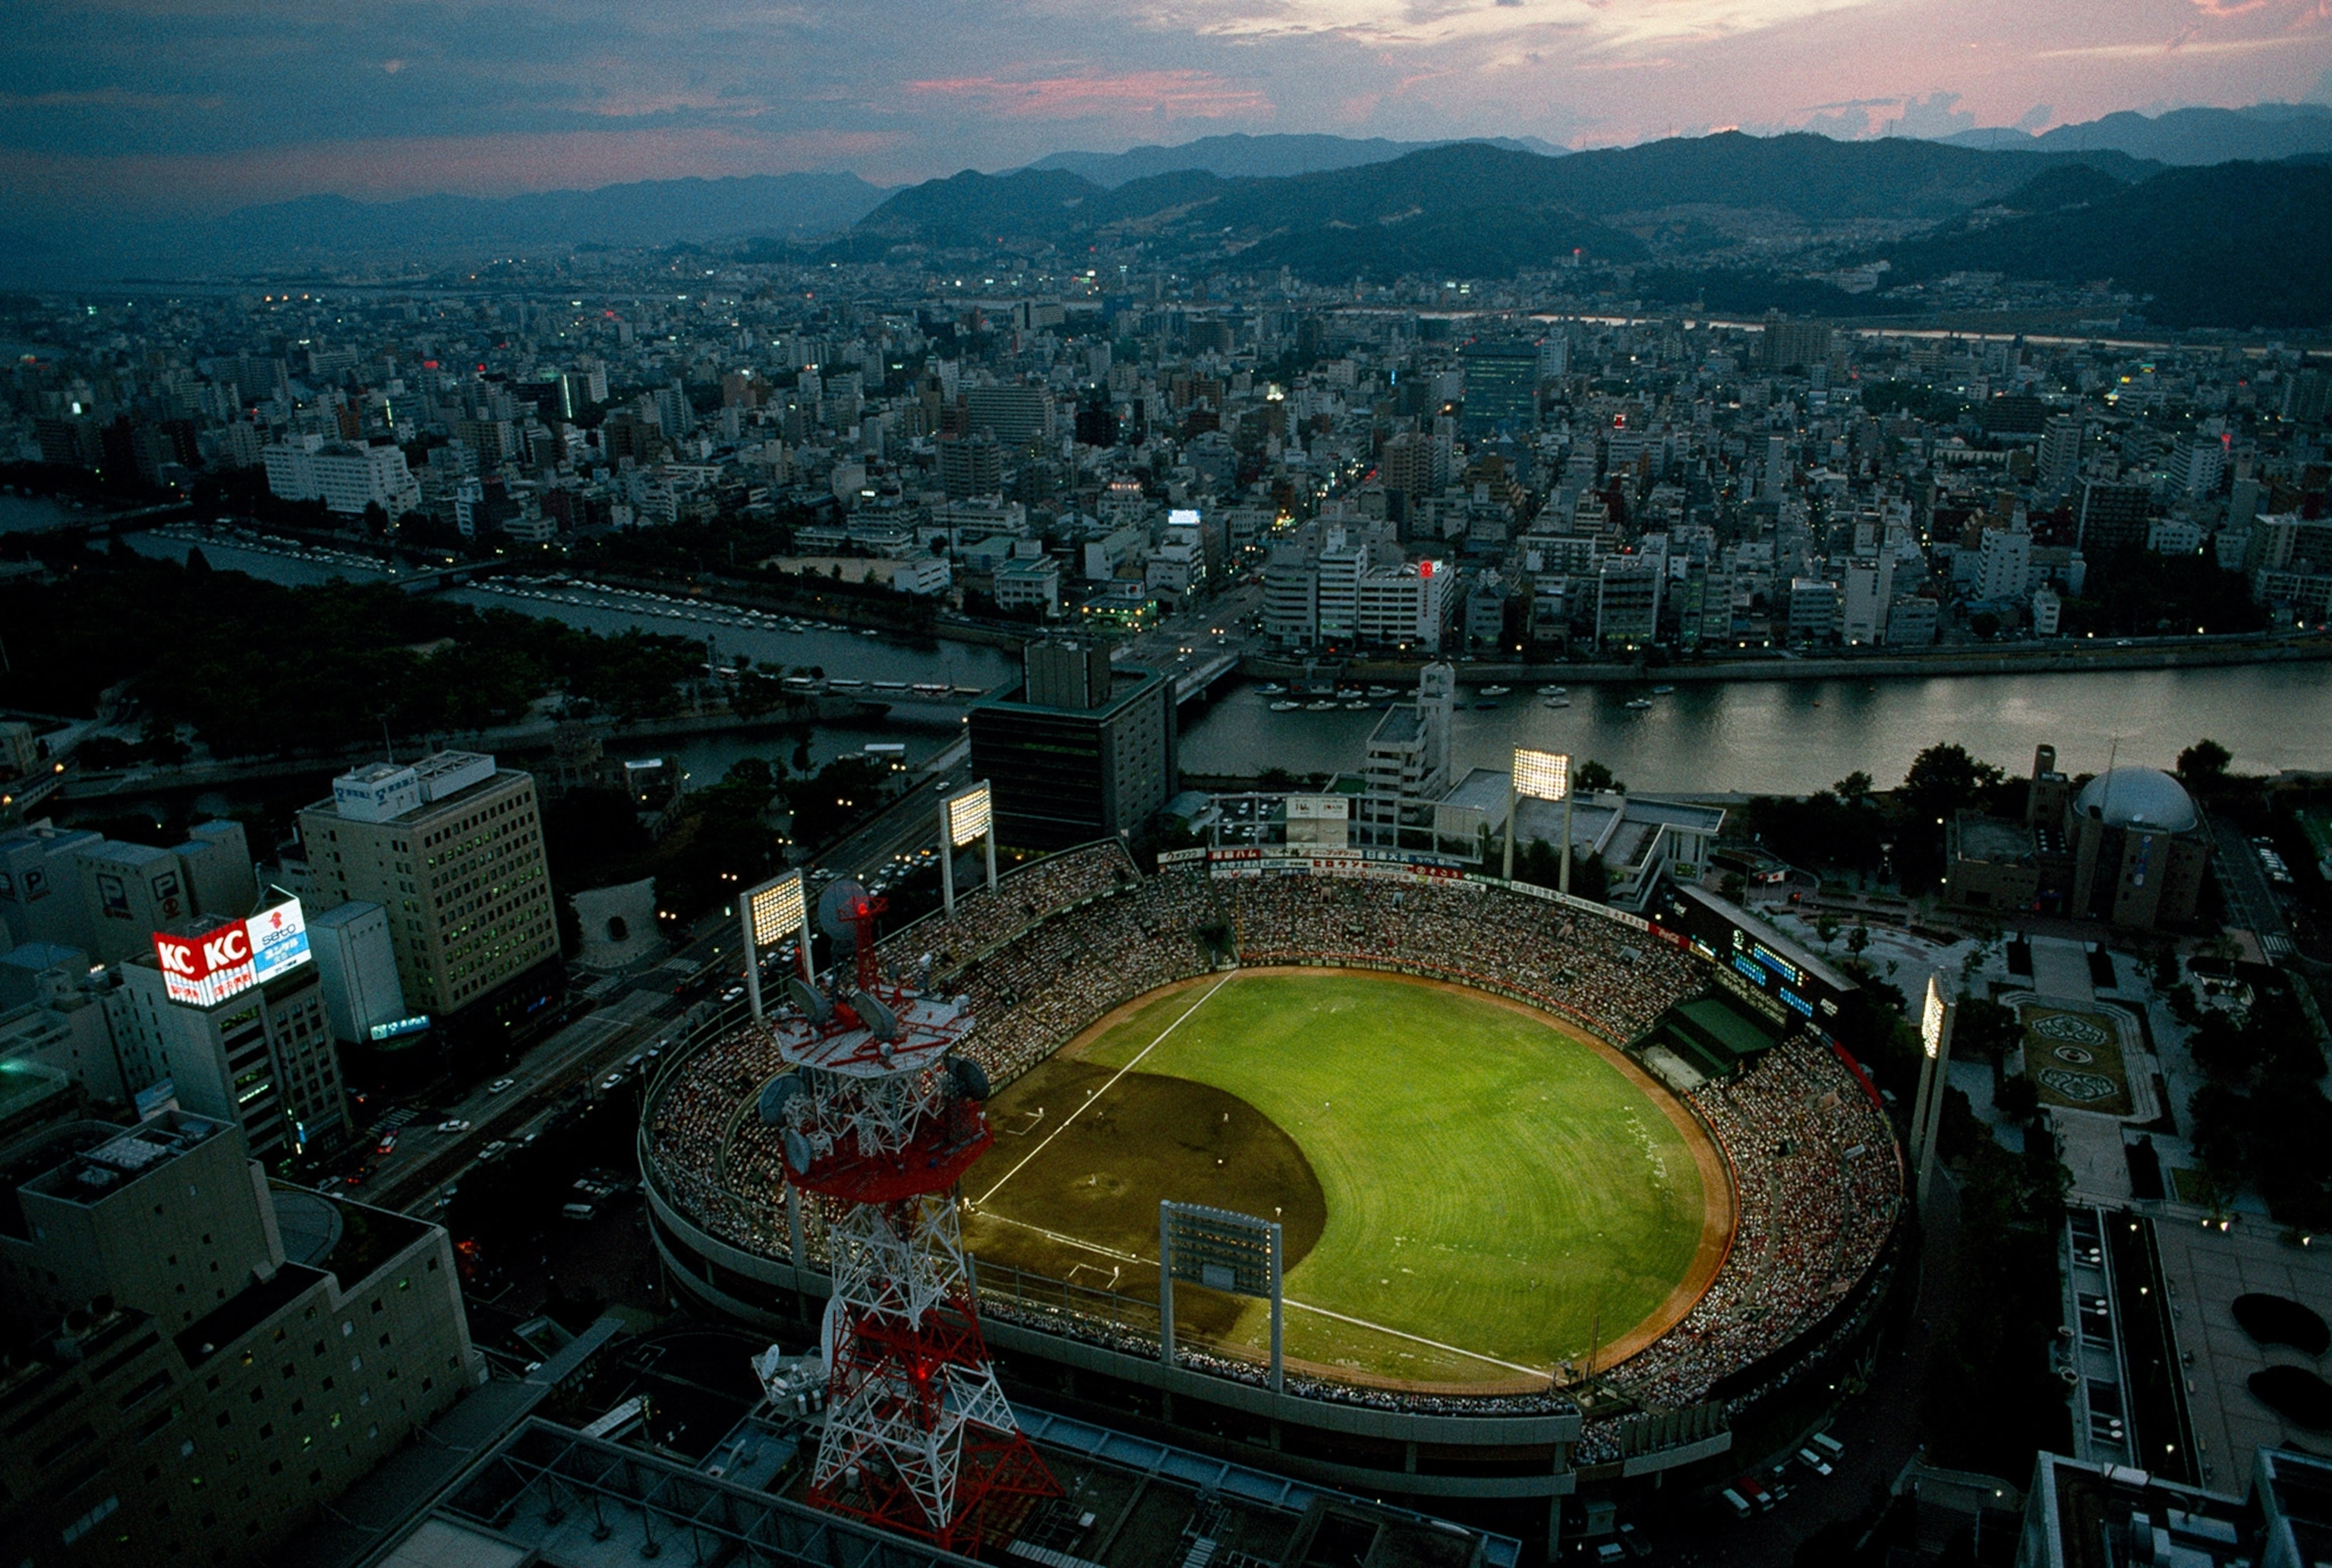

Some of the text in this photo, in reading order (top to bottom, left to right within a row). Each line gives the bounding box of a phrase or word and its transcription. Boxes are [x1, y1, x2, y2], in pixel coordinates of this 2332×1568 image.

[203, 930, 247, 971] KC
[262, 924, 296, 946] sato
[158, 942, 194, 974] KC
